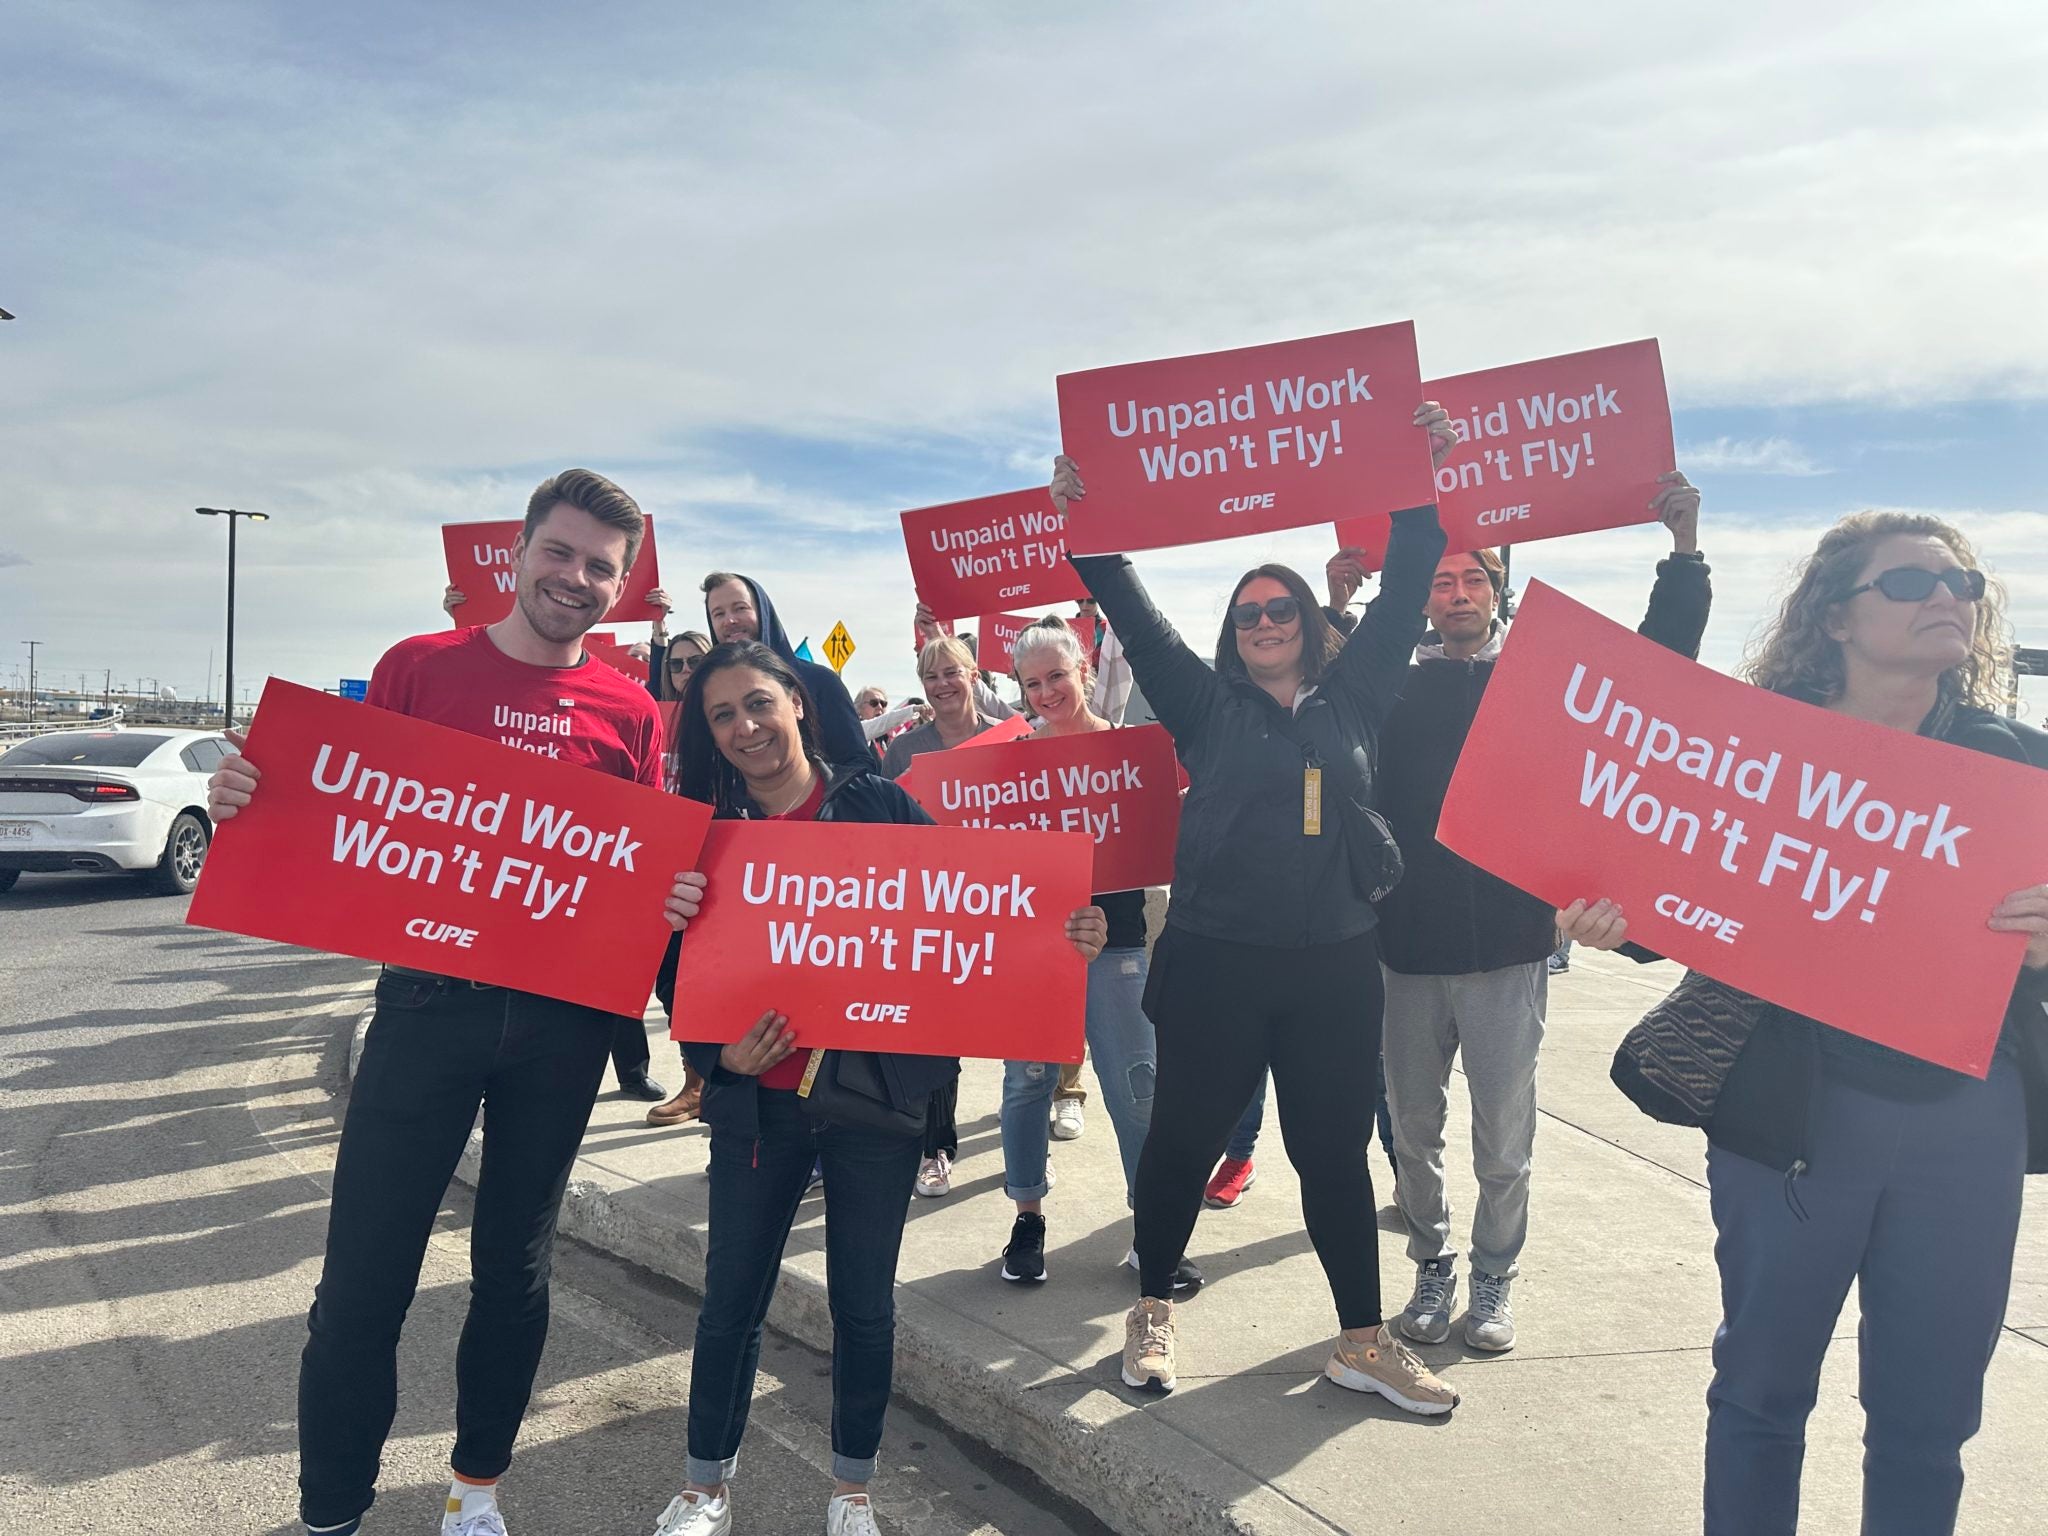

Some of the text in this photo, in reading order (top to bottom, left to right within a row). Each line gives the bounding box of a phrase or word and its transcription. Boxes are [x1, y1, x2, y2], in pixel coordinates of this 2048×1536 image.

[1108, 368, 1374, 440] Unpaid Work
[1451, 383, 1622, 445] aid Work
[1139, 420, 1343, 483] Won't Fly!
[1435, 431, 1595, 493] on't Fly!
[1219, 492, 1276, 515] CUPE
[1477, 503, 1531, 526] CUPE
[931, 511, 1065, 552] Unpaid Wor
[951, 538, 1067, 579] Won't Fly!
[999, 584, 1031, 598] CUPE
[494, 705, 571, 736] Unpaid
[941, 759, 1143, 814] Unpaid Work
[1564, 662, 1973, 868] Unpaid Work
[312, 744, 642, 872] Unpaid Work
[1060, 803, 1121, 844] Fly!
[1579, 749, 1891, 923] Won't Fly!
[332, 815, 588, 920] Won't Fly!
[742, 862, 1035, 918] Unpaid Work
[405, 918, 478, 948] CUPE
[1654, 893, 1744, 944] CUPE
[768, 920, 995, 985] Won't Fly!
[845, 1002, 910, 1025] CUPE
